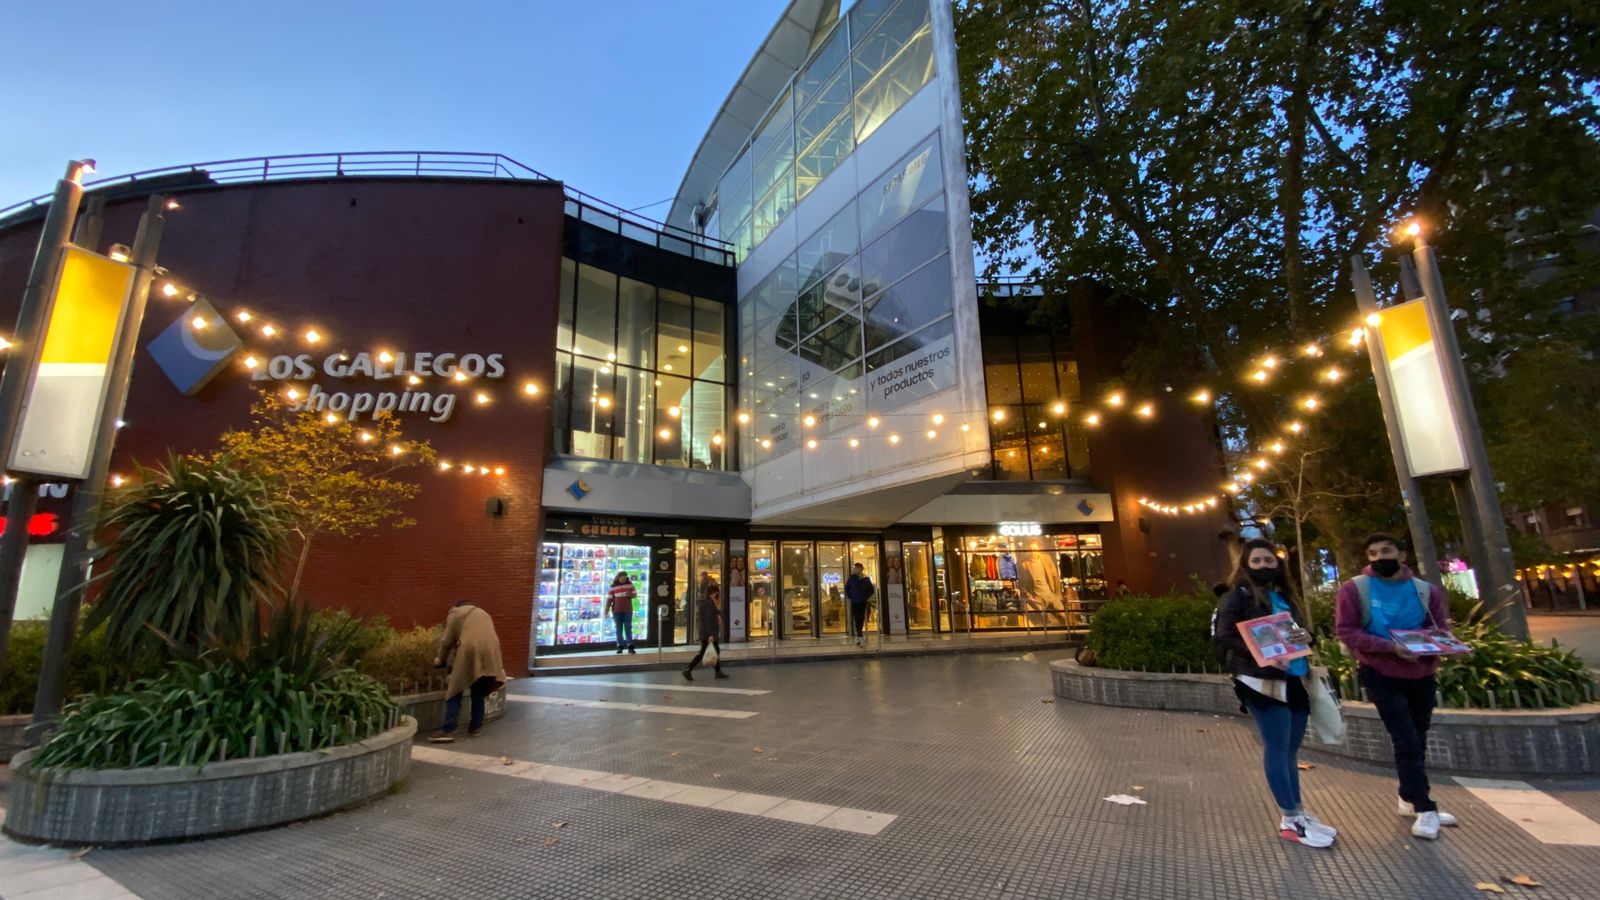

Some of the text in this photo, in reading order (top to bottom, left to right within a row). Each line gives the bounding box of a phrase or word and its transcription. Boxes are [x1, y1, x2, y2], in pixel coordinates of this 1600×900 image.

[251, 352, 505, 381] LOS GALLEGOS
[870, 347, 950, 392] y todos nuestros
[884, 369, 934, 399] productos
[288, 384, 457, 423] shopping
